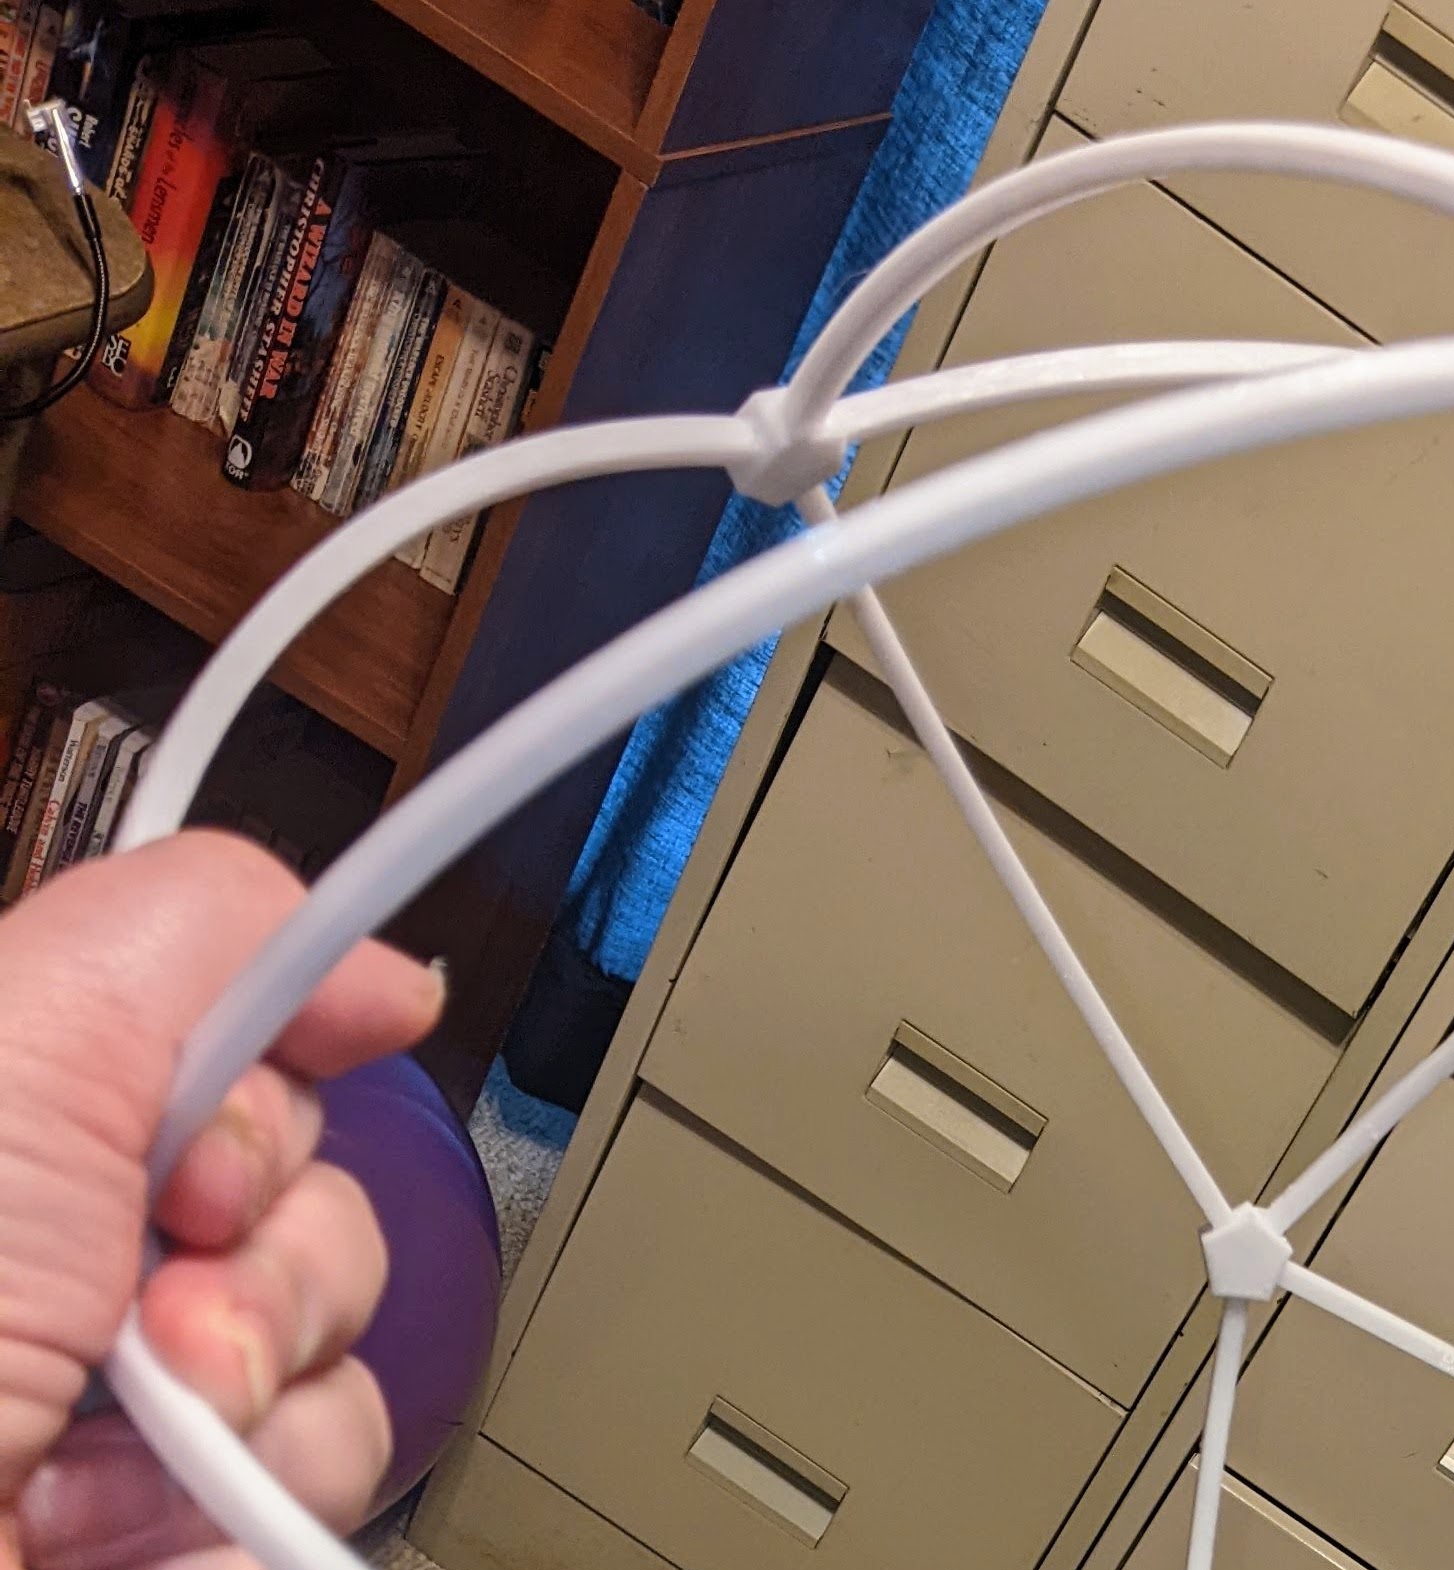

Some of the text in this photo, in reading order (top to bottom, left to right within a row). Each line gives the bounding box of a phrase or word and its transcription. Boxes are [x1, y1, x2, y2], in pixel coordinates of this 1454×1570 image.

[139, 176, 177, 246] Lensmen
[235, 156, 326, 422] CHRISTOPHER STASHEFF
[257, 196, 334, 400] A WIZARD IN WAR
